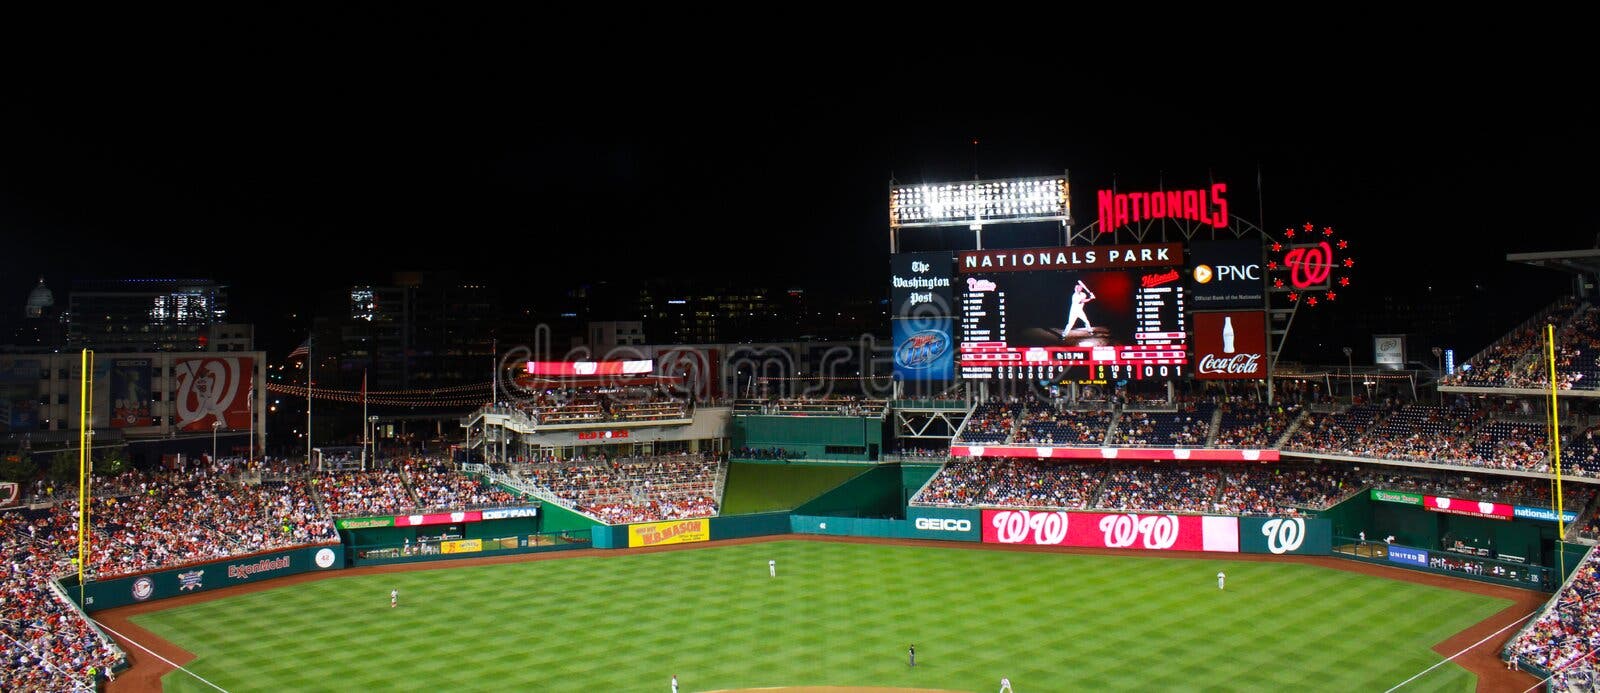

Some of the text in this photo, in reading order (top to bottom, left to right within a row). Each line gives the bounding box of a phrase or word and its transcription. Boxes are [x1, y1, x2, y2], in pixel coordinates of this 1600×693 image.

[1098, 183, 1228, 233] NATIONALS
[965, 248, 1169, 268] NATIONALS PARK
[1284, 241, 1332, 289] W
[911, 261, 930, 273] The
[1216, 264, 1260, 281] PNC
[893, 275, 950, 289] Washington
[910, 292, 933, 305] Post
[1199, 353, 1262, 374] Coca-Cola
[1145, 366, 1181, 377] 0 0 1
[510, 508, 536, 518] FAN
[916, 517, 971, 531] GEICO
[1390, 551, 1417, 560] UNITED
[228, 556, 290, 578] ExxonMobil
